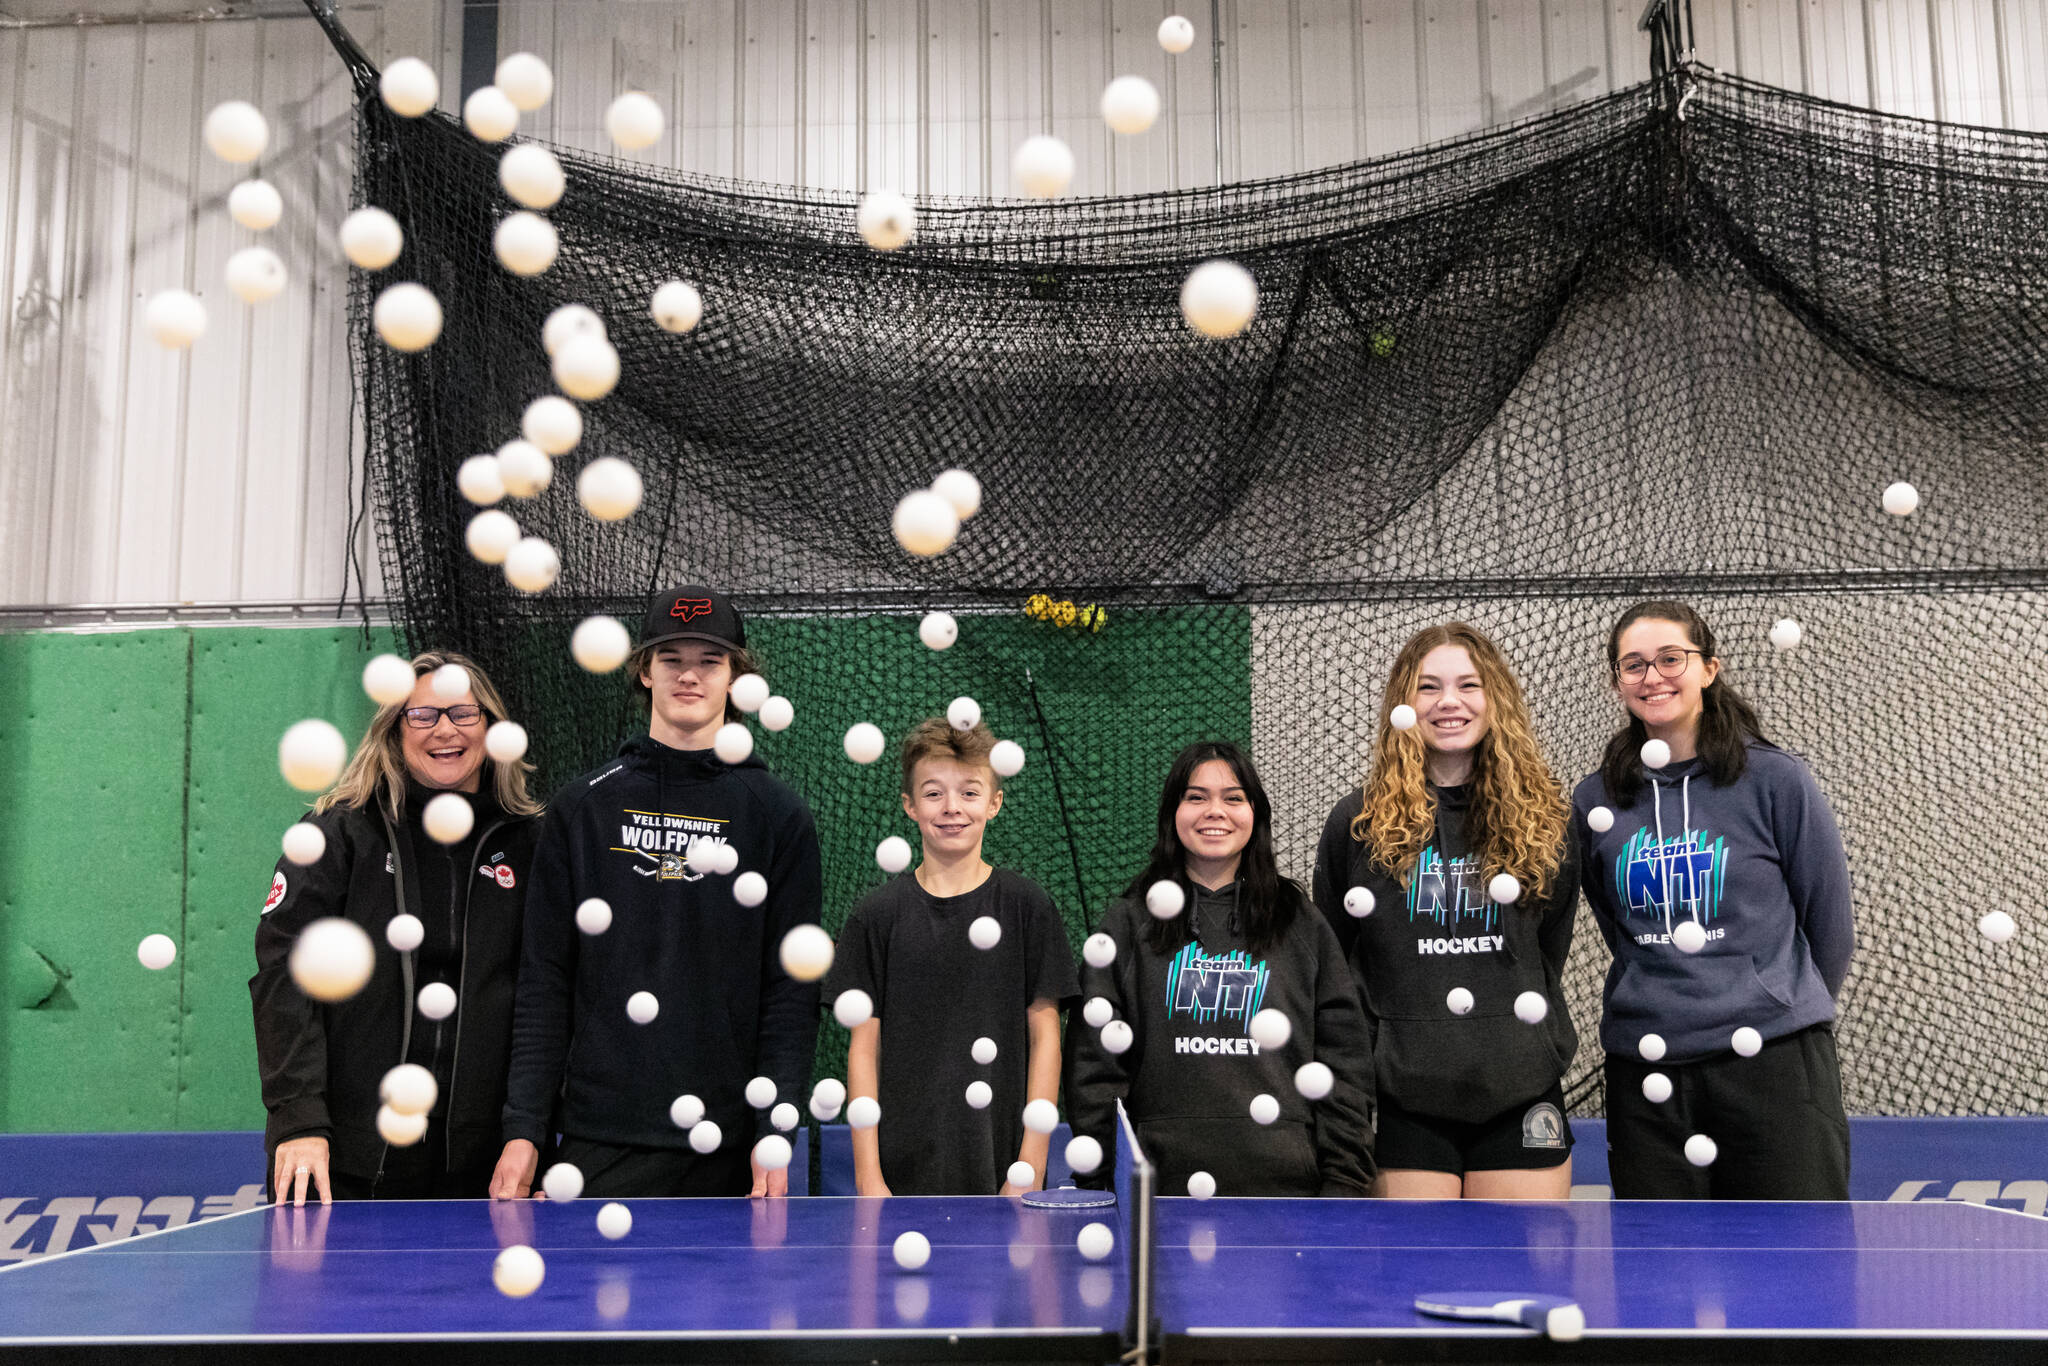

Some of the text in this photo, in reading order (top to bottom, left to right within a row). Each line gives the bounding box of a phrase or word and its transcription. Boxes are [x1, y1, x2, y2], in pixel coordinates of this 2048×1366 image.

[632, 814, 721, 834] YELLOWKNIFE
[621, 825, 728, 853] WOLFPA
[1637, 840, 1698, 861] team
[1626, 850, 1715, 909] NT
[1417, 934, 1504, 955] HOCKEY
[1190, 957, 1245, 970] team
[1175, 967, 1259, 1011] NT
[1175, 1036, 1261, 1056] HOCKEY
